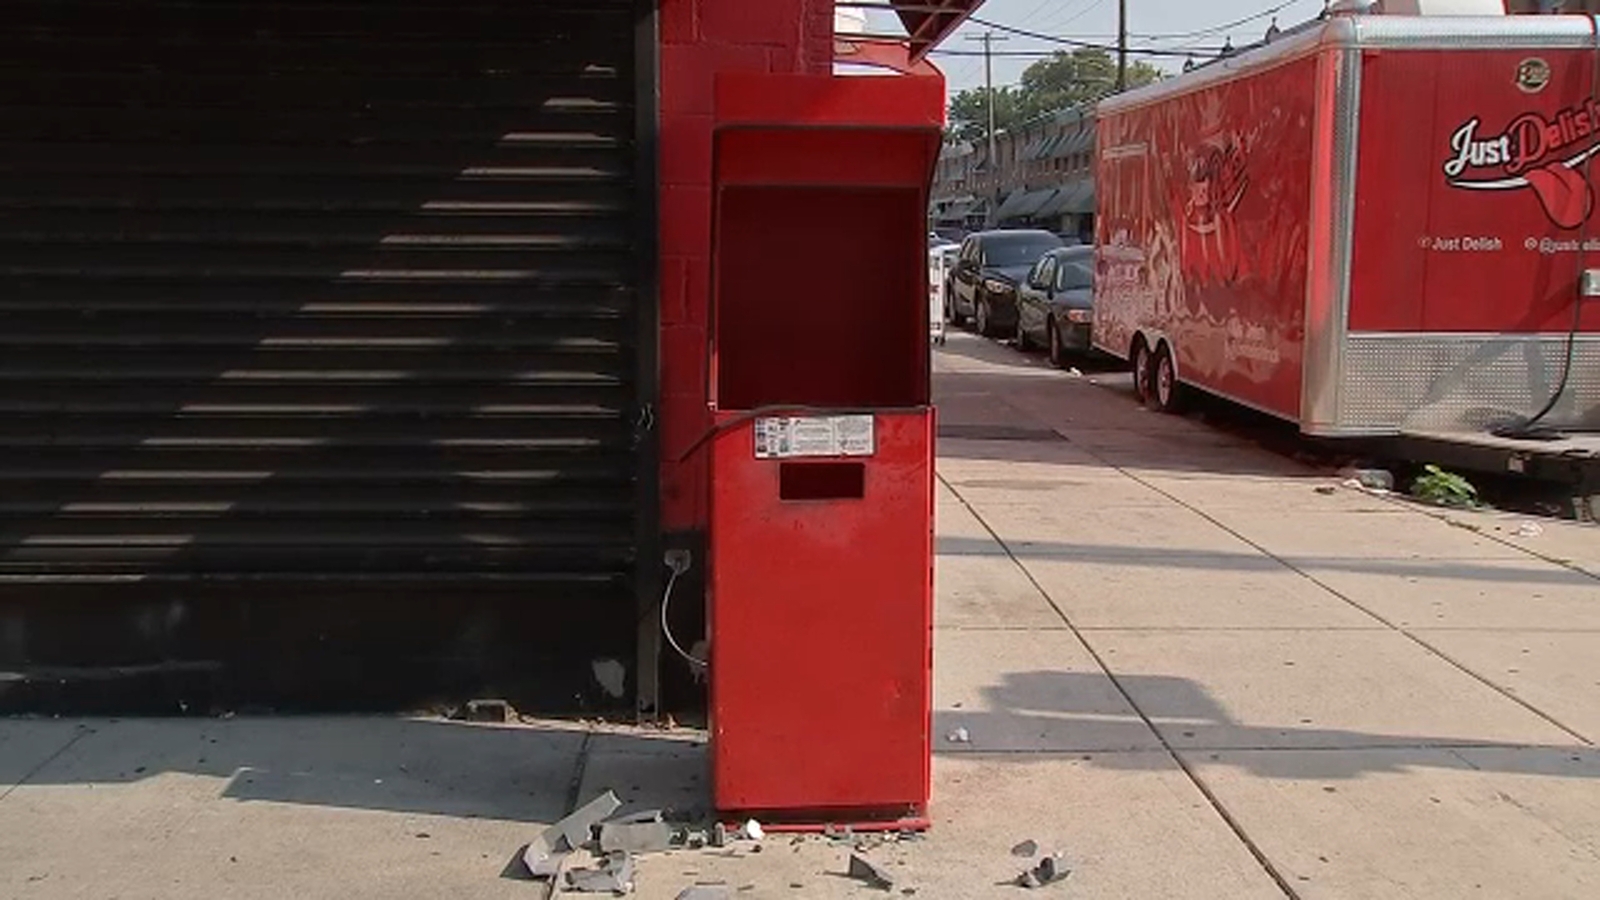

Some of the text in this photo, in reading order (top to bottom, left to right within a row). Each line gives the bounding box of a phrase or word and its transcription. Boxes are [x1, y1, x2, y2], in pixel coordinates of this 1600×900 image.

[1445, 118, 1511, 176] Just
[1432, 236, 1502, 251] Just Delish
